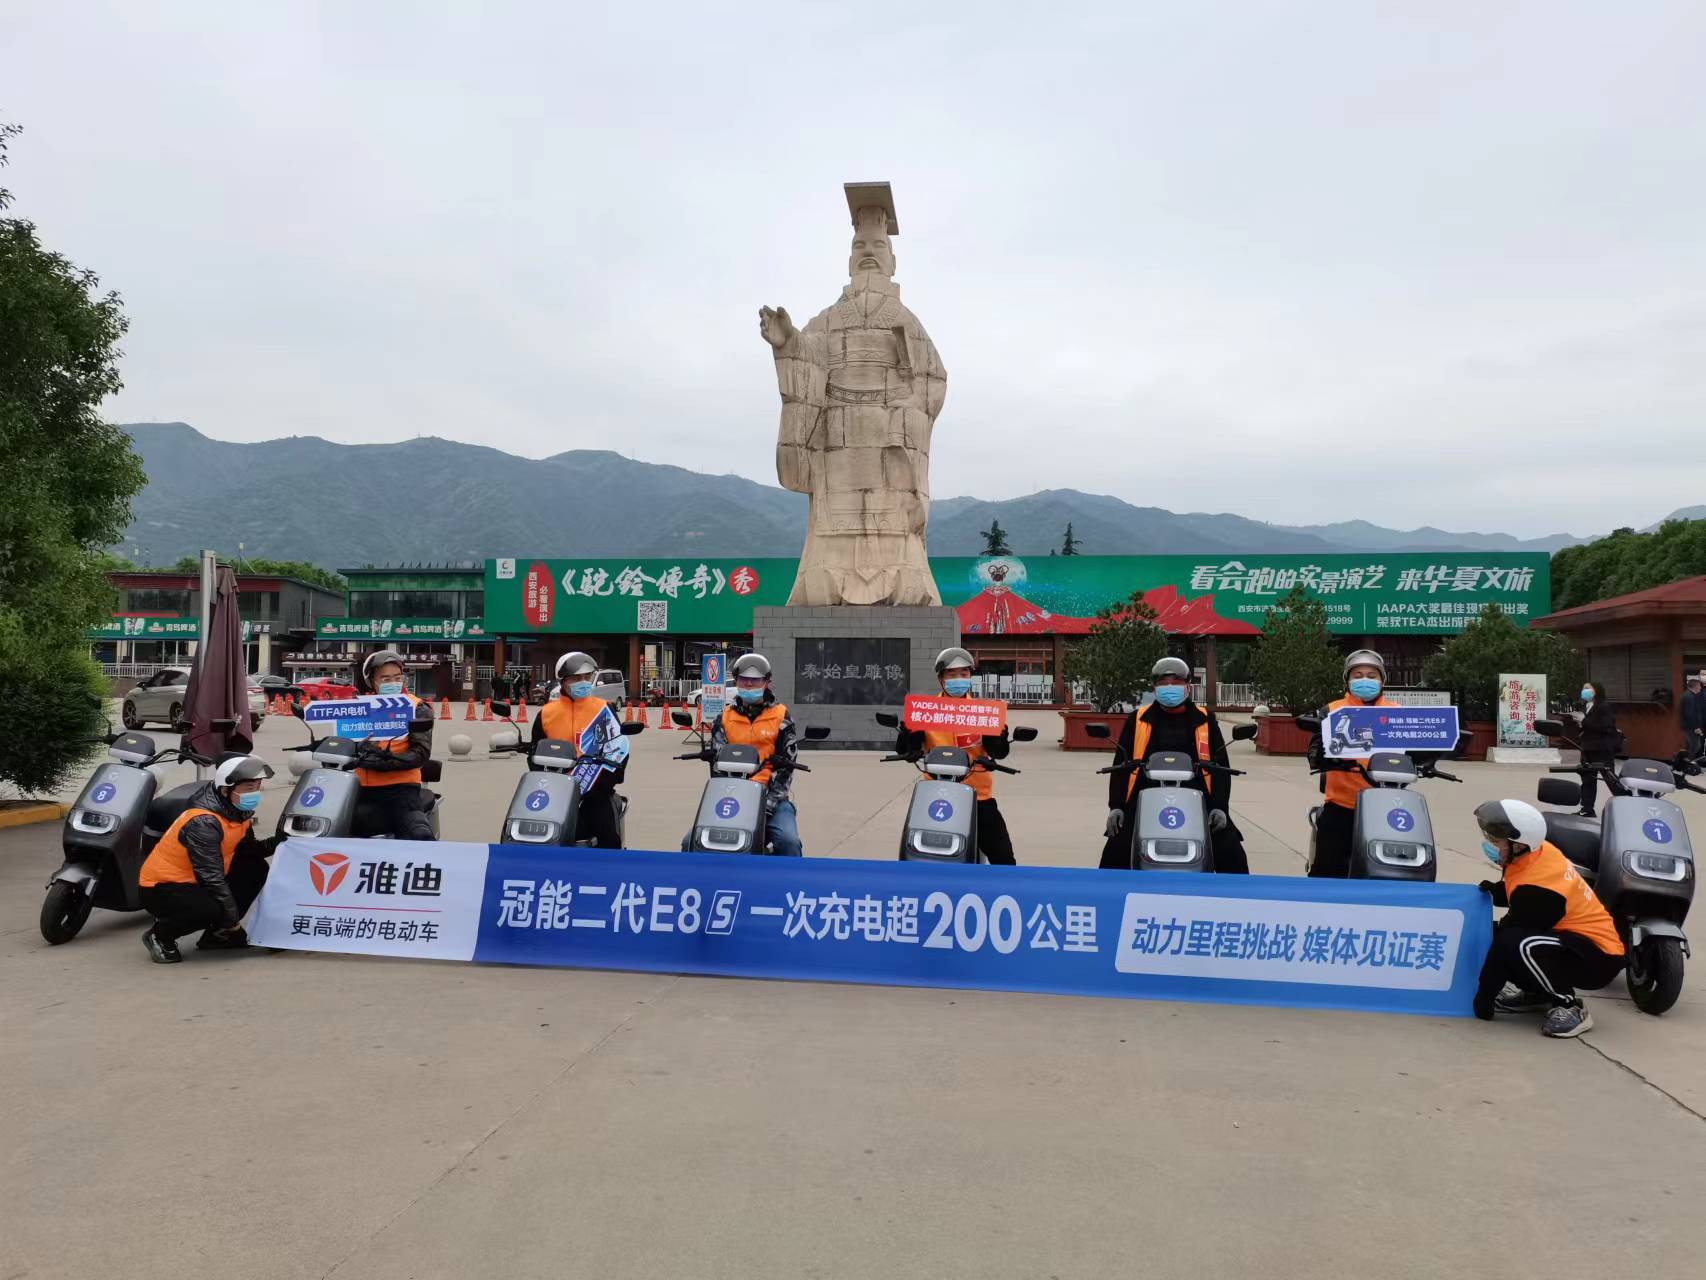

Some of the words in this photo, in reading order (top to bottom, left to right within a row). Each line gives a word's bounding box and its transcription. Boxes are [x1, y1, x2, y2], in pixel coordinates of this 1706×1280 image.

[1190, 561, 1386, 595] 看会跑的实景演艺
[1395, 565, 1535, 594] 来华夏文旅
[527, 571, 538, 608] 西安旅游
[539, 585, 549, 622] 必看演出
[339, 624, 370, 633] 青岛啤酒
[412, 625, 442, 634] 青岛啤酒
[802, 663, 905, 680] 秦始皇雕像
[911, 701, 939, 711] YADEA
[1509, 680, 1520, 721] 旅游咨询
[312, 706, 367, 718] TTFAR电机
[911, 711, 1000, 728] 核心部件双倍质保
[97, 790, 107, 801] 8
[306, 794, 316, 805] 7
[532, 798, 540, 809] 6
[722, 805, 731, 816] 5
[936, 807, 945, 818] 4
[1168, 815, 1177, 826] 3
[1397, 817, 1406, 829] 2
[1654, 828, 1662, 841] 1
[355, 861, 442, 896] 雅迪
[291, 914, 440, 943] 更高端的电动车
